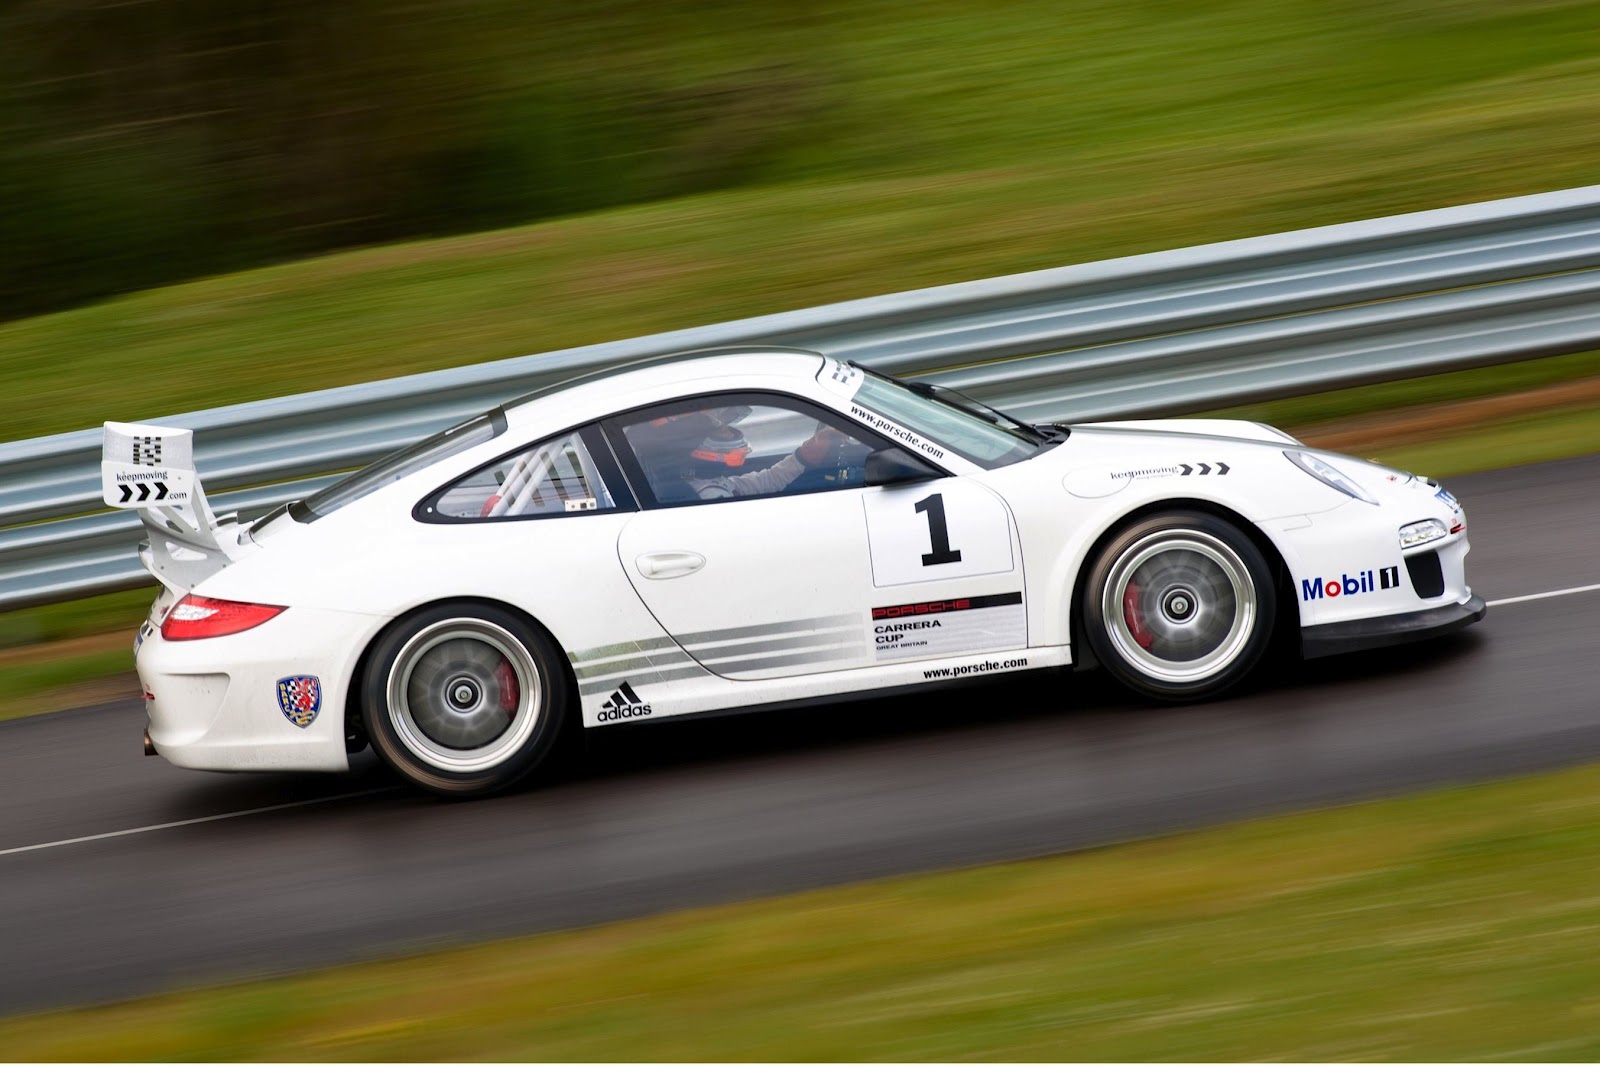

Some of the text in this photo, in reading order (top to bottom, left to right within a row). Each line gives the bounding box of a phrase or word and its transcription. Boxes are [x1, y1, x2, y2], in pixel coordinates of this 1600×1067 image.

[851, 405, 944, 459] www.porsche.com
[116, 470, 168, 483] keepmoving
[1110, 466, 1179, 479] keepmoving
[914, 493, 962, 567] 1
[1302, 567, 1396, 601] Mobil 1
[872, 599, 970, 618] PORSCHE
[874, 620, 942, 634] CARRERA
[875, 634, 904, 644] CUP
[876, 640, 928, 651] GREAT BRITAIN
[923, 656, 1029, 680] www.porsche.com
[597, 703, 652, 722] adidas
